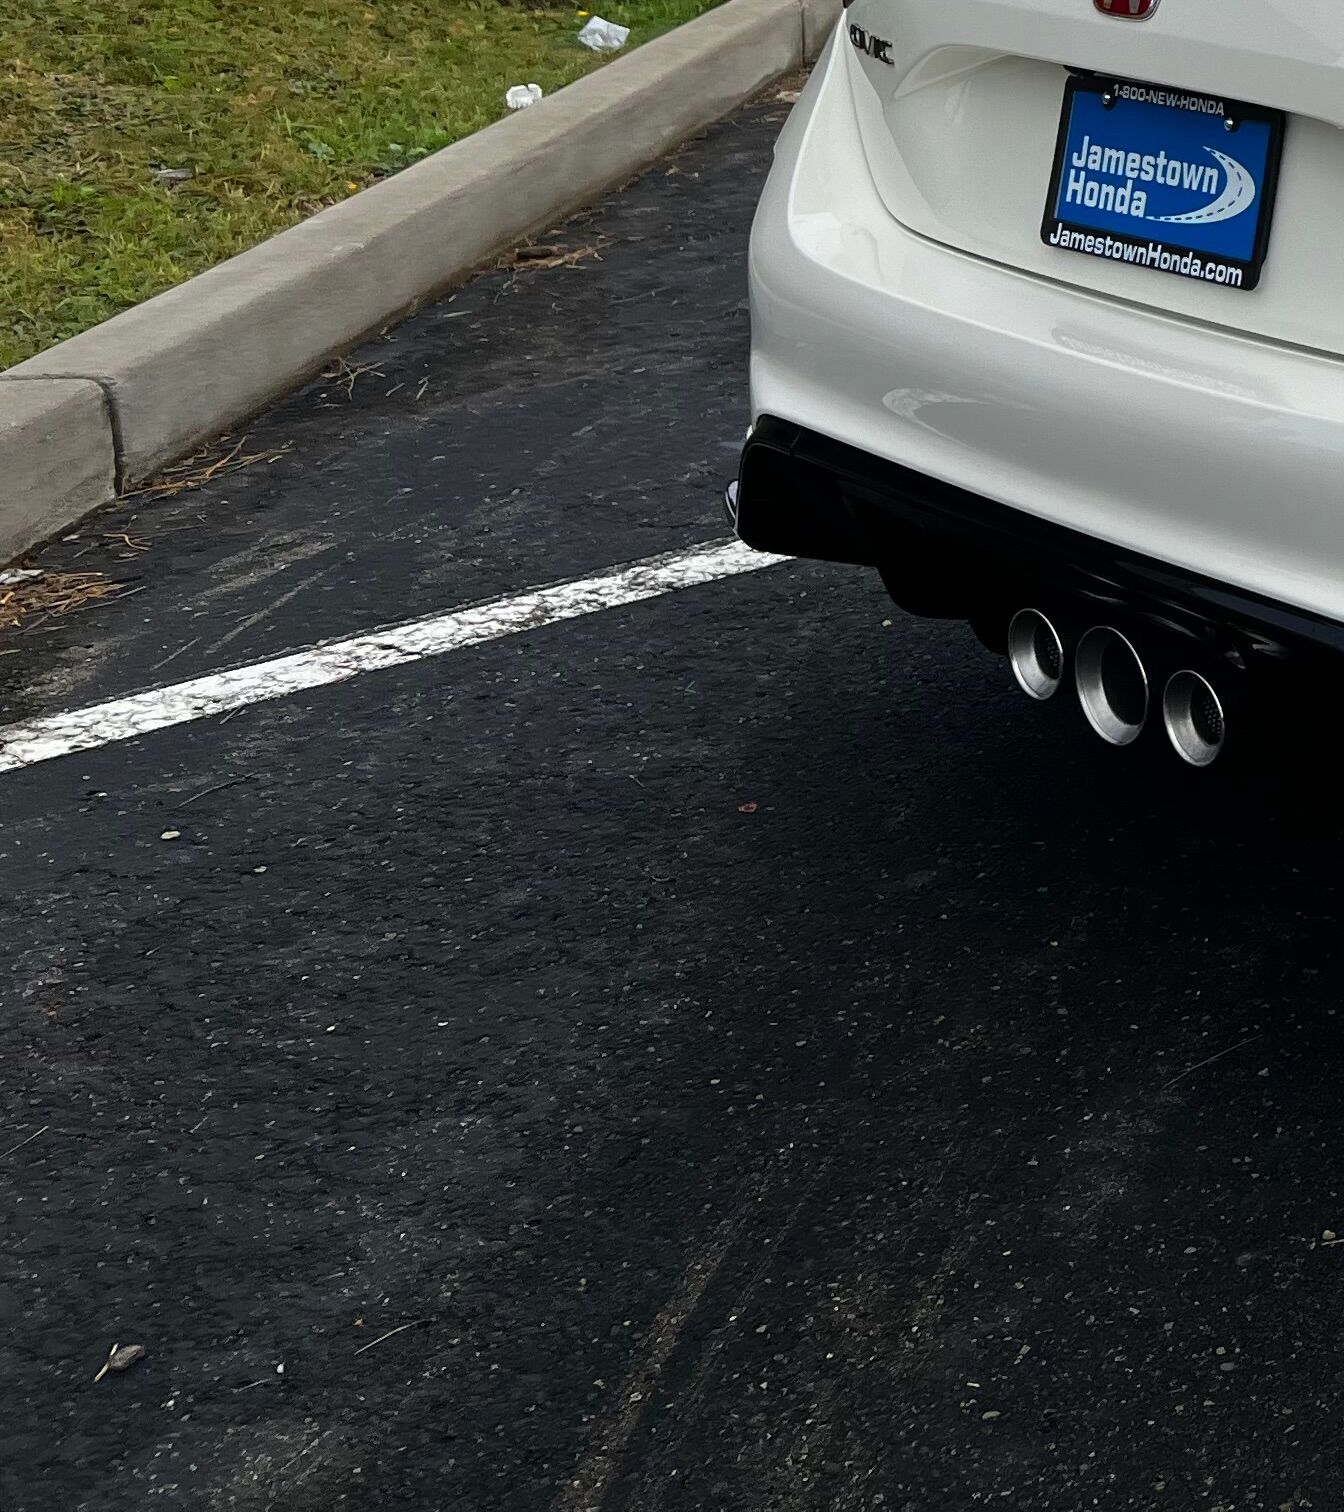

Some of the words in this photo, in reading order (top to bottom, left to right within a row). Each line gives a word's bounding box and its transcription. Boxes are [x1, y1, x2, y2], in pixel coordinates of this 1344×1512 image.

[1113, 84, 1225, 116] 1-800-NEW-HONDA
[1072, 135, 1219, 195] Jamestown
[1065, 169, 1148, 218] Honda
[1049, 223, 1243, 287] JamestownHonda.com
